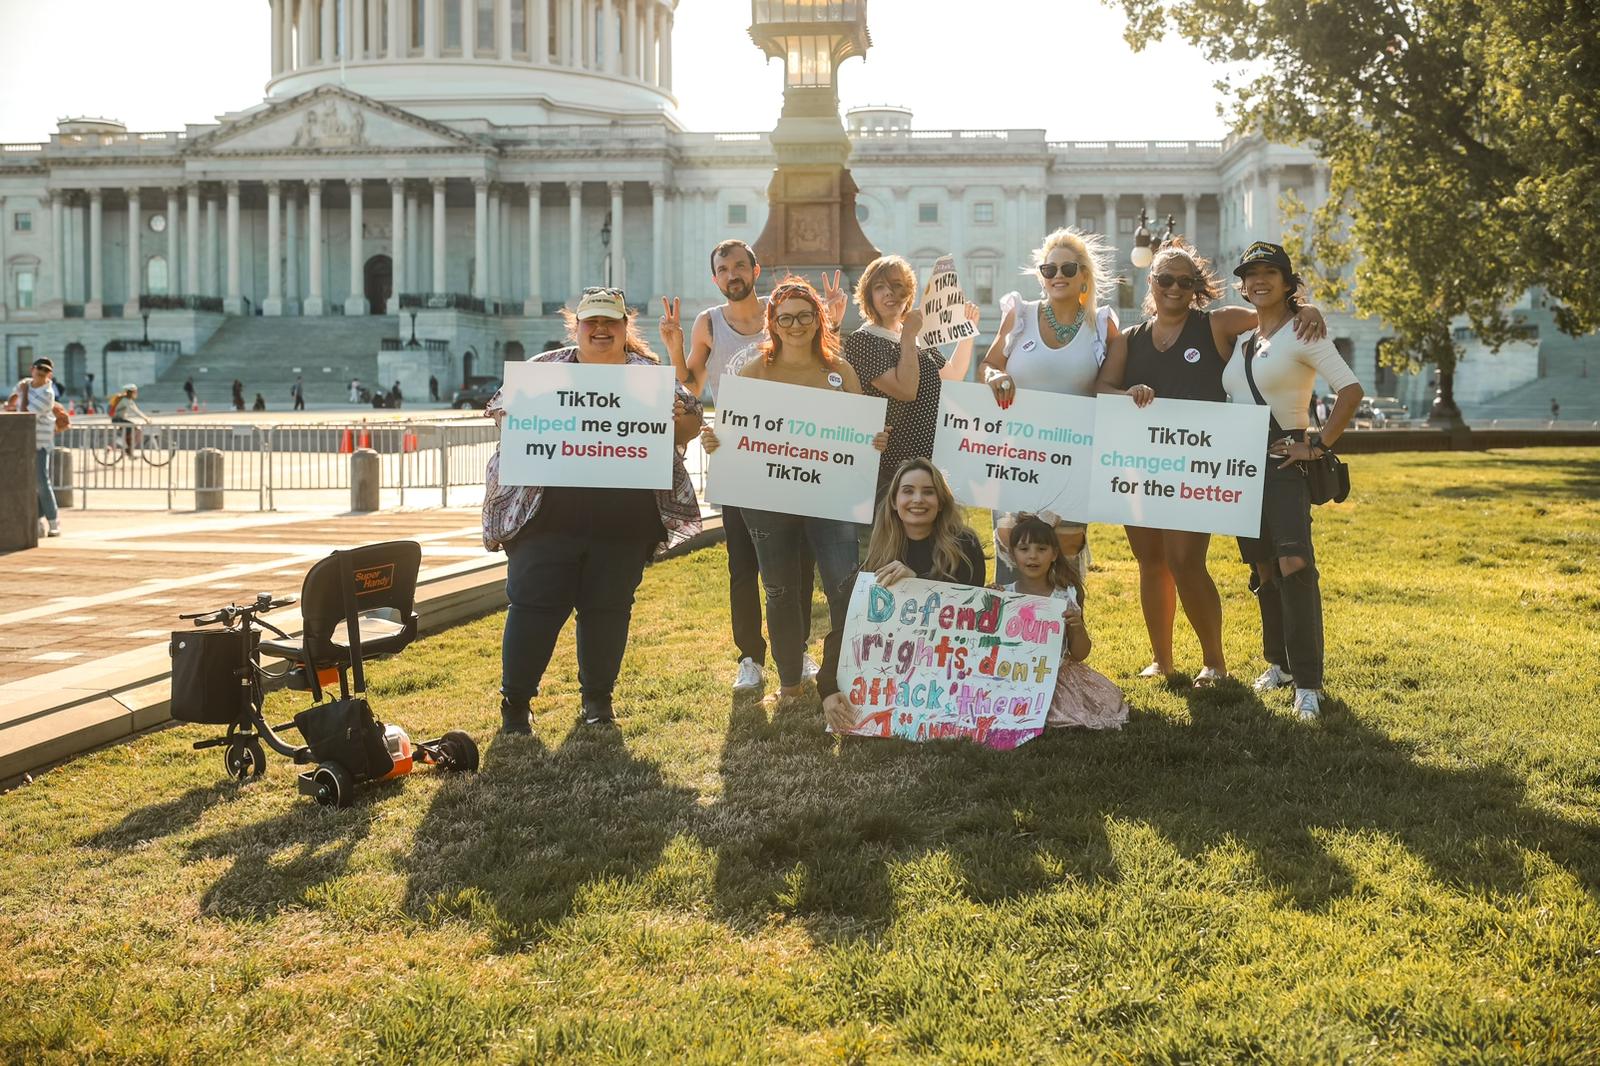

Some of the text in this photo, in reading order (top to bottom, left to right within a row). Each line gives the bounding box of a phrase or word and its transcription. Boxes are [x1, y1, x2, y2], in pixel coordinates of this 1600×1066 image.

[925, 298, 942, 316] WILL
[939, 310, 952, 325] YOU
[923, 330, 946, 347] VOTE,
[557, 390, 621, 409] TikTok
[508, 414, 667, 437] helped me grow
[722, 409, 748, 428] I'm
[753, 414, 760, 428] 1
[764, 417, 784, 433] of
[788, 420, 817, 437] 170
[943, 413, 1094, 446] I'm 1 of 170 million
[1148, 426, 1213, 448] TikTok
[526, 440, 648, 460] my business
[737, 435, 855, 466] Americans on
[958, 438, 1072, 466] Americans on
[766, 462, 822, 484] TikTok
[985, 464, 1039, 485] TikTok
[1100, 450, 1258, 478] changed my life
[1111, 476, 1243, 504] for the better
[355, 570, 382, 582] Super
[364, 576, 390, 589] Handy
[867, 583, 1061, 644] Defend our
[979, 644, 1052, 683] don't
[850, 676, 944, 710] attack
